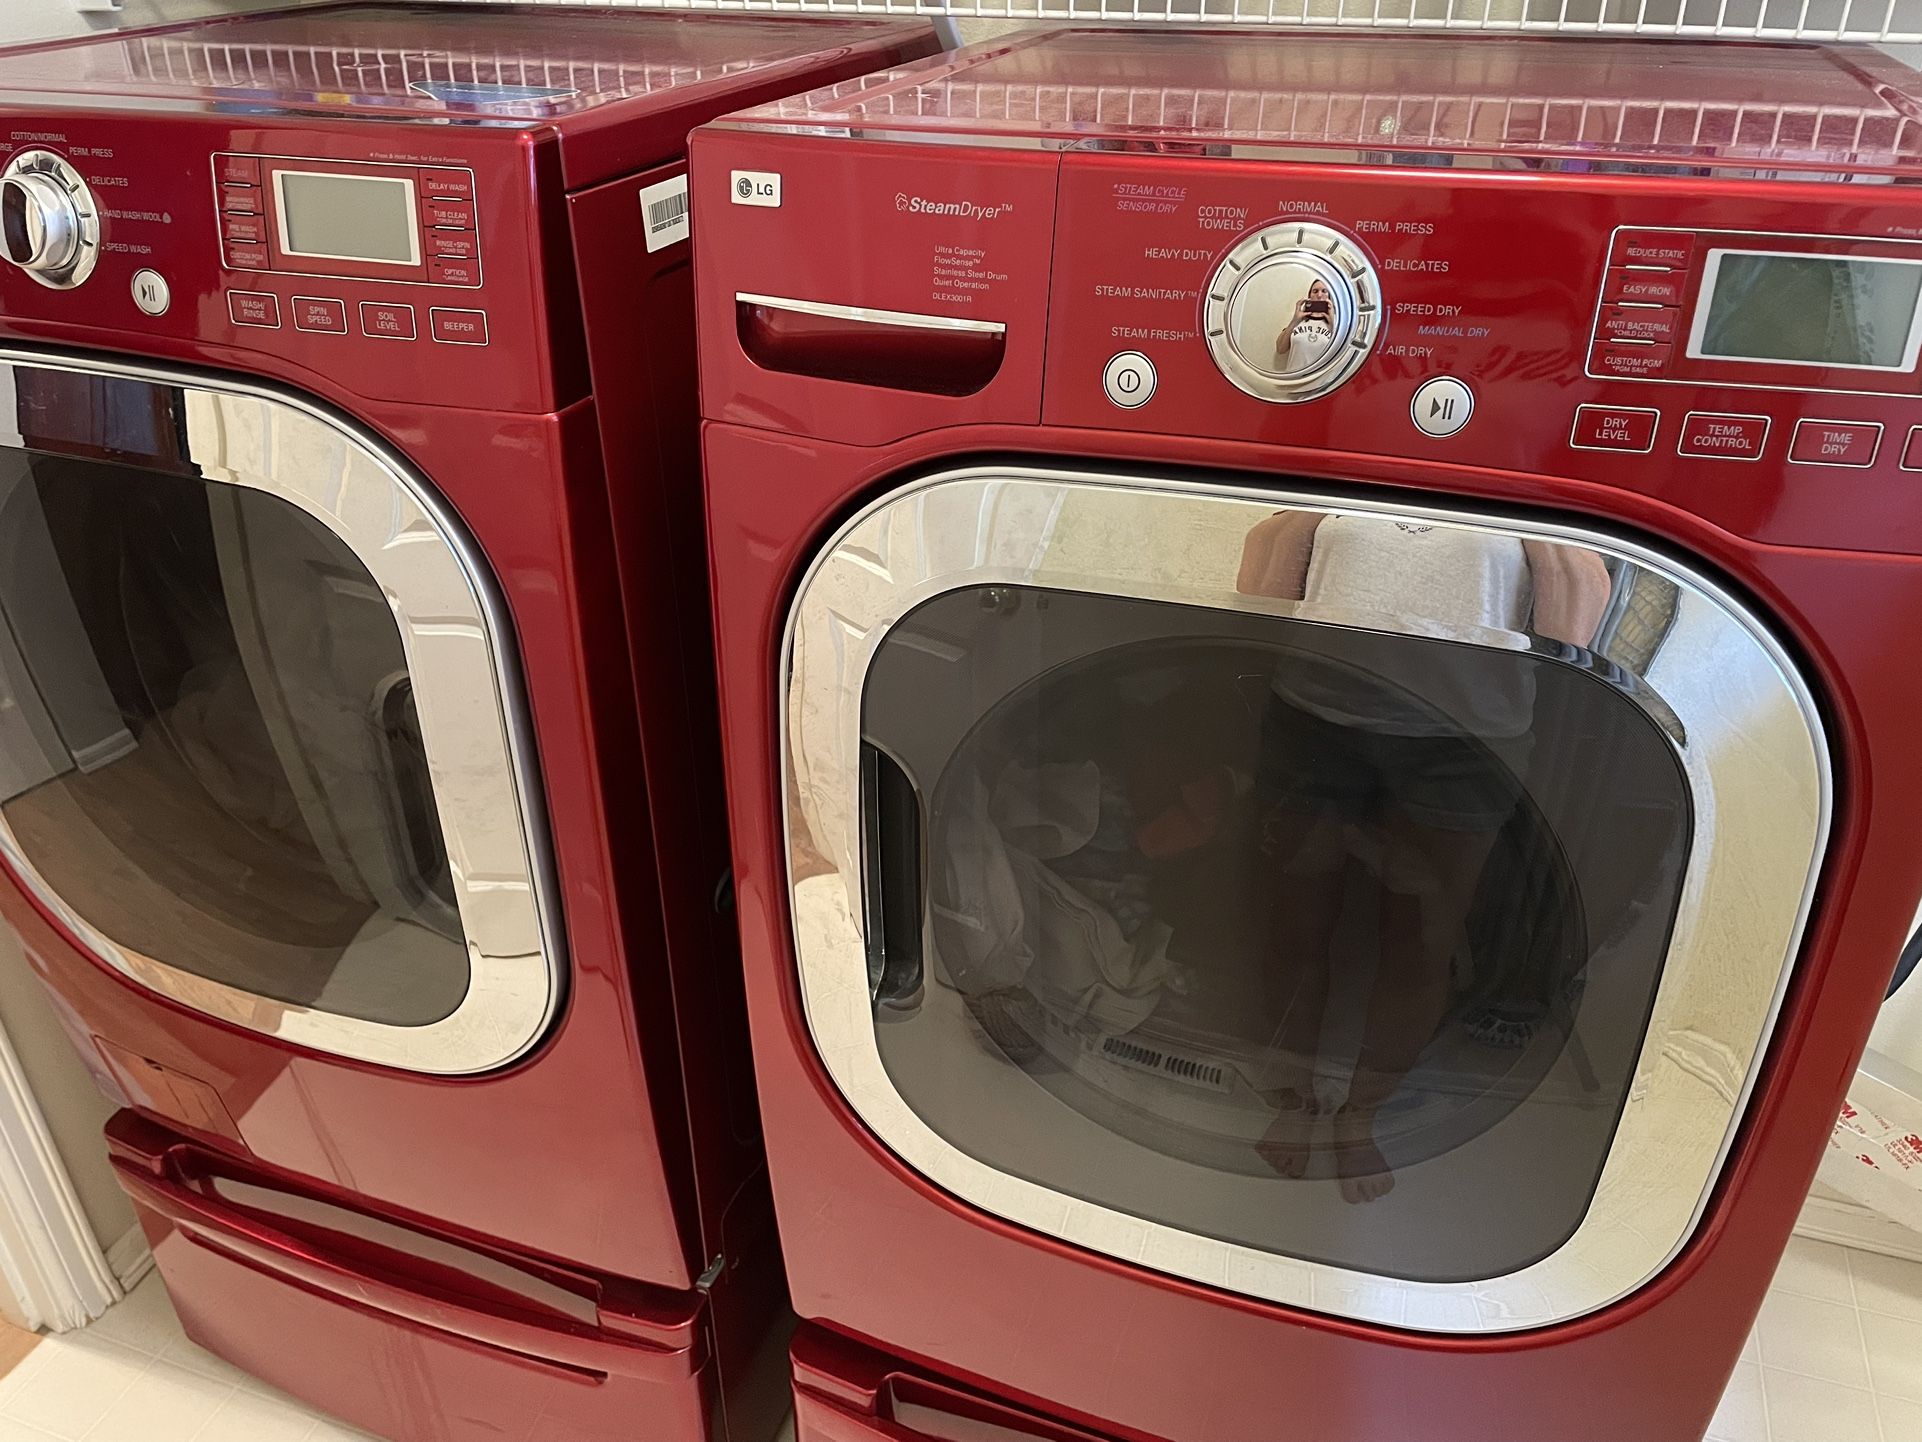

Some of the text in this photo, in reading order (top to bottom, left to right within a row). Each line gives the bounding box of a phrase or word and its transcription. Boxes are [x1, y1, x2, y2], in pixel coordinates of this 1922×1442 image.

[11, 131, 67, 142] COTTON/NORMAL
[69, 147, 113, 157] PERM. PRESS
[224, 169, 248, 177] STEAM
[91, 176, 128, 187] DELICATES
[429, 182, 467, 191] DELAY WASH
[756, 183, 773, 196] LG
[1155, 186, 1187, 198] CYCLE
[1116, 200, 1178, 214] SENSOR DRY
[1198, 206, 1249, 219] COTTON/
[1278, 201, 1328, 213] NORMAL
[104, 209, 162, 222] HAND WASH/WOOL
[434, 210, 446, 218] TUB
[1198, 218, 1245, 231] TOWELS
[1355, 220, 1434, 235] PERM. PRESS
[106, 242, 151, 254] SPEED WASH
[934, 245, 986, 258] Ultra Capacity
[1144, 247, 1213, 261] HEAVY DUTY
[1626, 247, 1685, 259] REDUCE STATIC
[1384, 259, 1449, 272] DELICATES
[444, 268, 467, 276] OPTION
[933, 267, 1008, 281] Stainless Steel Drum
[933, 277, 990, 290] Quiet Operation
[1095, 285, 1131, 297] STEAM
[1623, 284, 1671, 296] EASY IRON
[932, 292, 972, 302] DLEX3001R
[240, 300, 265, 310] WASH/
[308, 305, 327, 316] SPIN
[1395, 303, 1462, 317] SPEED DRY
[243, 309, 265, 319] RINSE
[307, 315, 332, 325] SPEED
[378, 311, 396, 321] SOIL
[376, 321, 400, 331] LEVEL
[443, 321, 474, 332] BEEPER
[1111, 326, 1148, 338] STEAM
[1417, 325, 1490, 338] MANUAL DRY
[1605, 320, 1671, 333] ANTI BACTERIAL
[1386, 345, 1434, 358] AIR DRY
[1604, 356, 1662, 368] CUSTOM PGM
[1603, 417, 1629, 428] DRY
[1595, 429, 1631, 441] LEVEL
[1708, 424, 1743, 437] TEMP.
[1693, 435, 1752, 449] CONTROL
[1822, 431, 1853, 444] TIME
[1821, 444, 1848, 455] DRY
